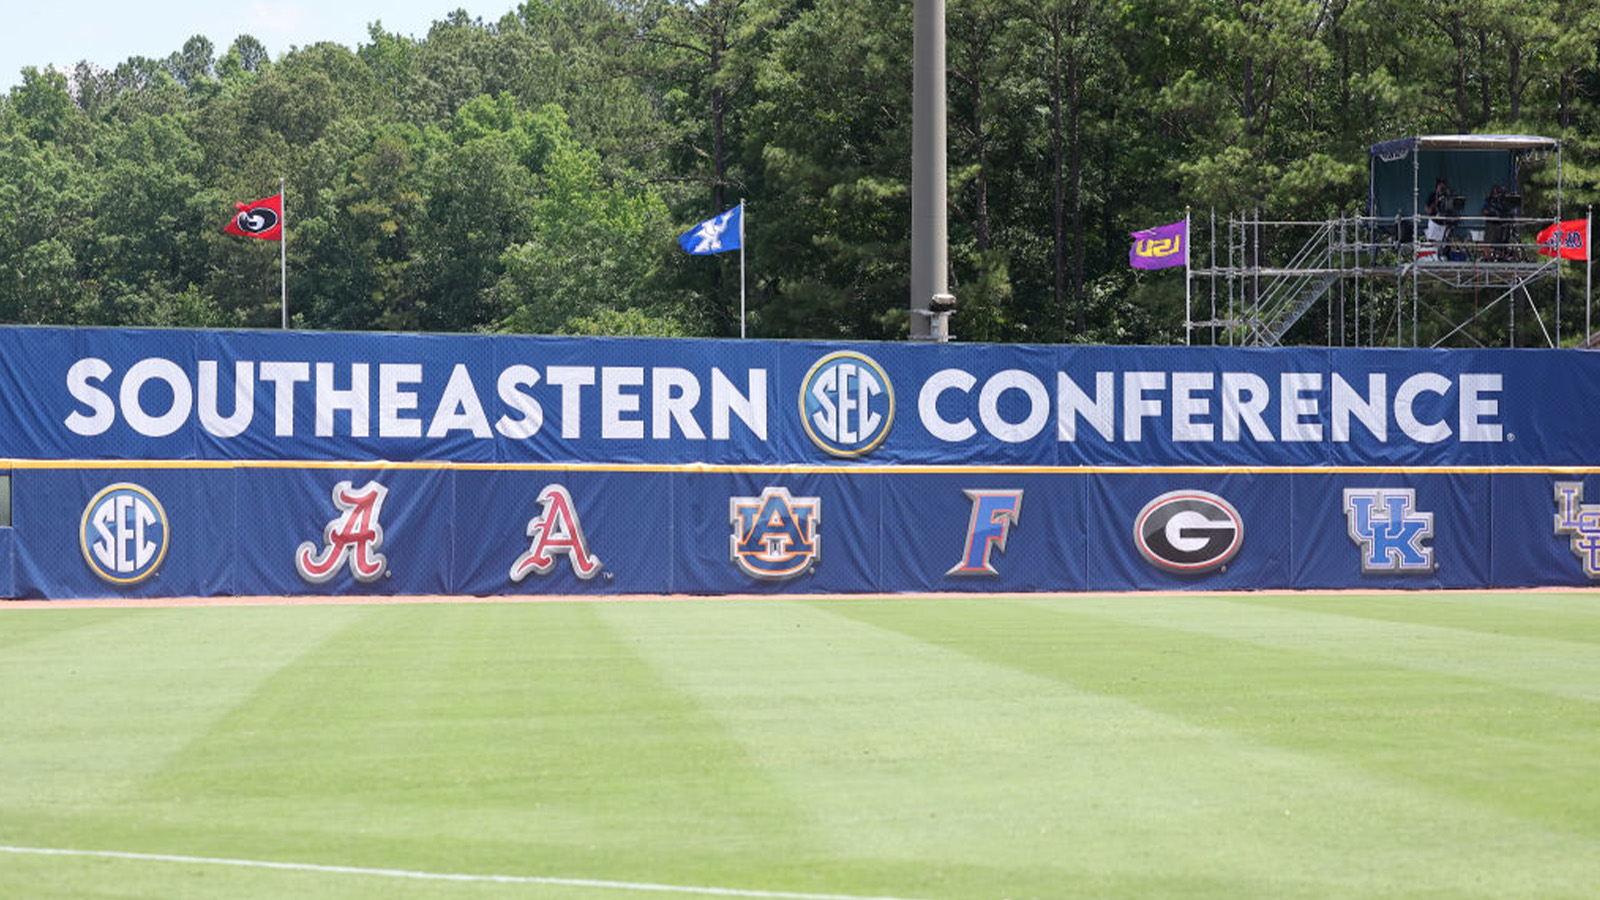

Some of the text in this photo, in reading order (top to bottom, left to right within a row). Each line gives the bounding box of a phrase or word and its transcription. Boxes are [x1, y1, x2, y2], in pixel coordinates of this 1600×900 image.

[63, 357, 1503, 444] SOUTHEASTERN SEC CONFERENCE
[92, 495, 157, 573] SEC
[299, 484, 386, 579] A
[513, 487, 598, 578] A
[945, 488, 1024, 576] F
[1164, 510, 1237, 552] G
[1346, 490, 1432, 572] UK
